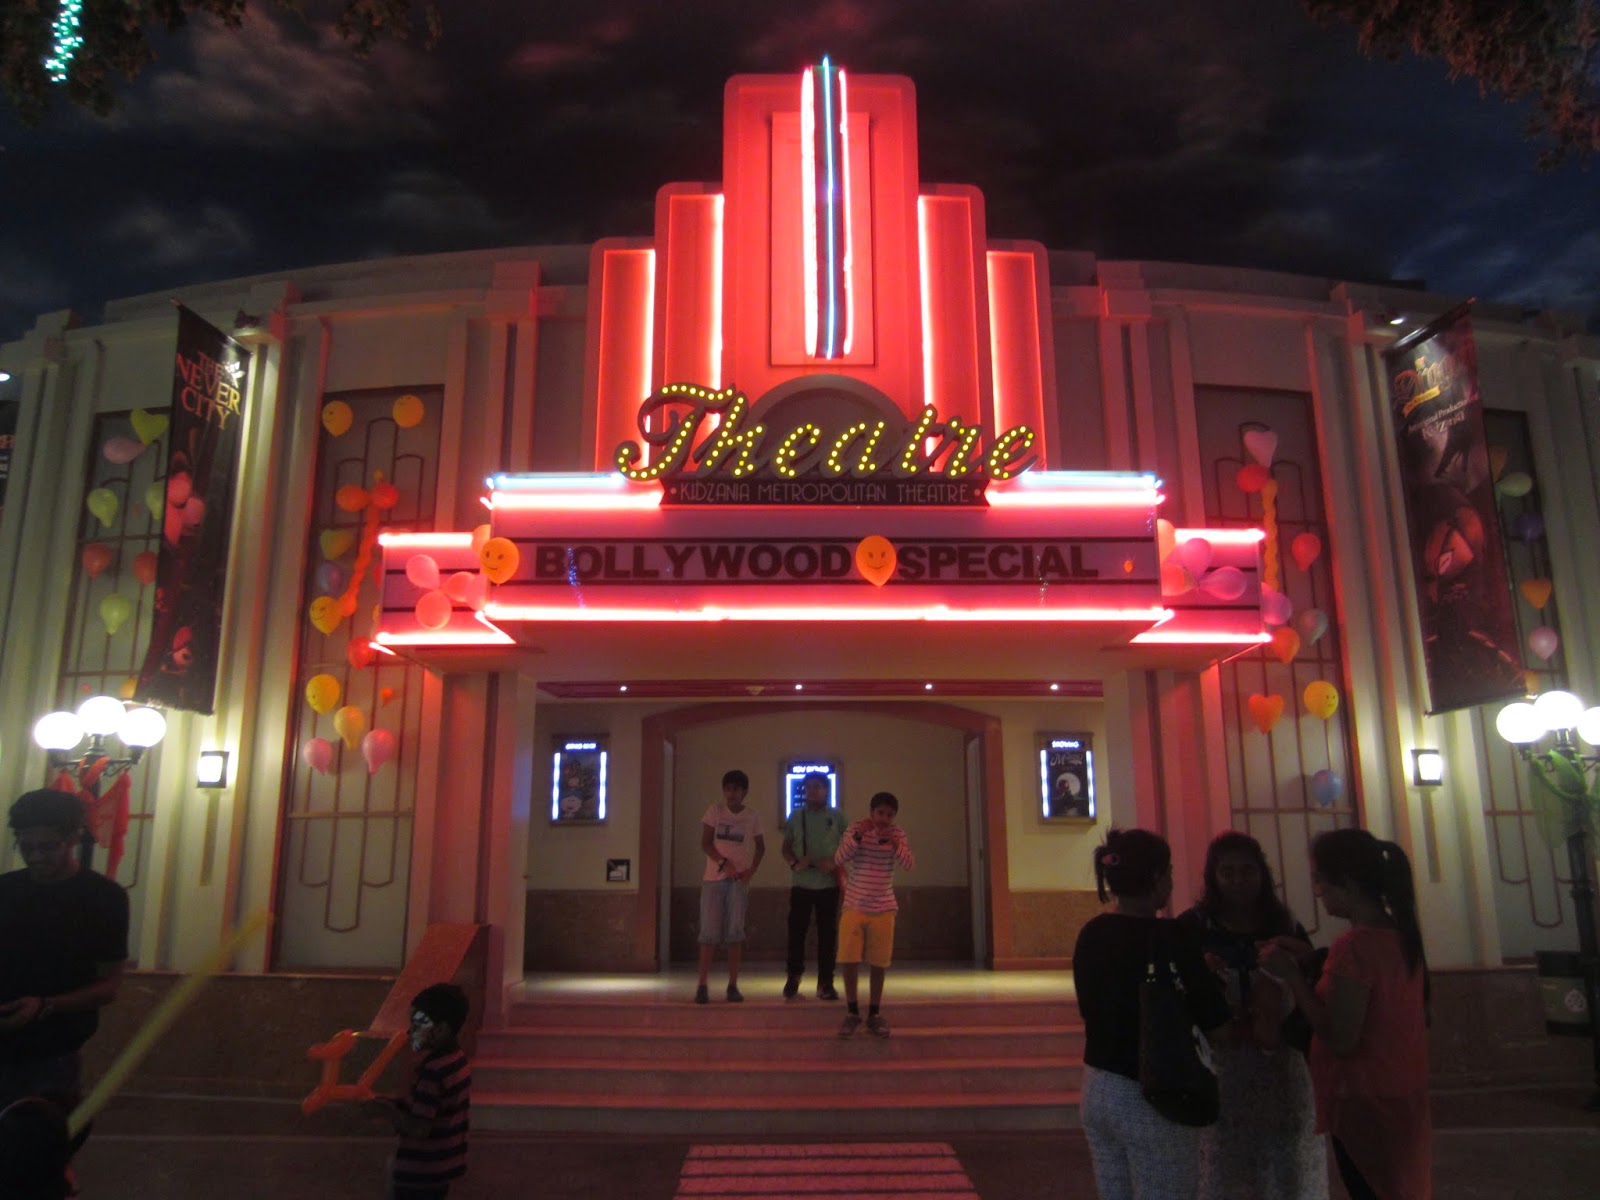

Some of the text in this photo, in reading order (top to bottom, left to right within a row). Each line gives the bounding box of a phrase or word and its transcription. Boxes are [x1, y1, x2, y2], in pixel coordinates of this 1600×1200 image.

[176, 352, 241, 416] NEVER
[198, 351, 227, 379] THE
[181, 386, 231, 430] CITY
[614, 383, 1038, 481] Theatre
[680, 482, 969, 503] KIDZANIA METROPOLITAN THEATRE
[534, 544, 1099, 580] BOLLYWOOD SPECIAL
